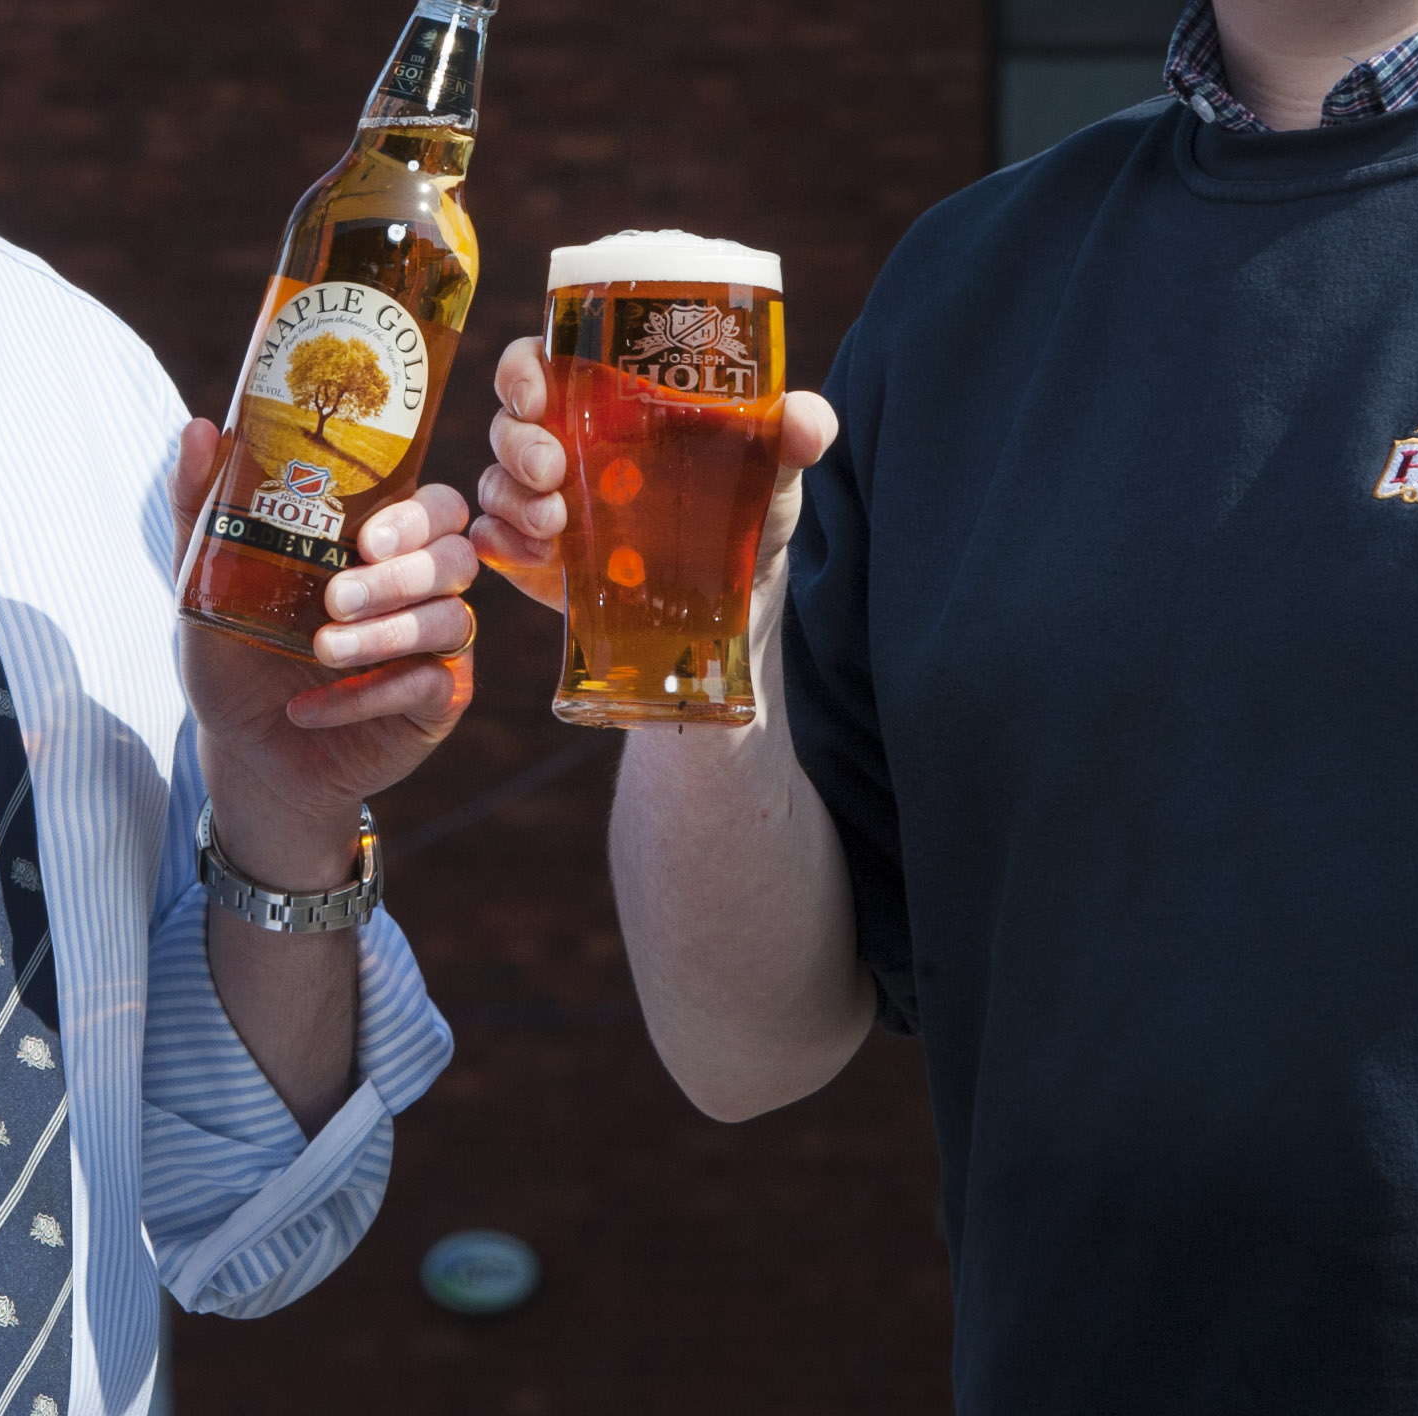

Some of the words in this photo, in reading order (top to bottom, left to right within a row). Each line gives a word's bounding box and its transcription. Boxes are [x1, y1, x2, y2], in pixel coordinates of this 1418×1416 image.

[257, 287, 365, 371] MAPLE
[376, 304, 423, 410] GOLD
[659, 351, 725, 366] JOSEPH
[627, 364, 752, 393] HOLT
[254, 495, 340, 533] HOLT
[278, 493, 320, 510] JOSEPH
